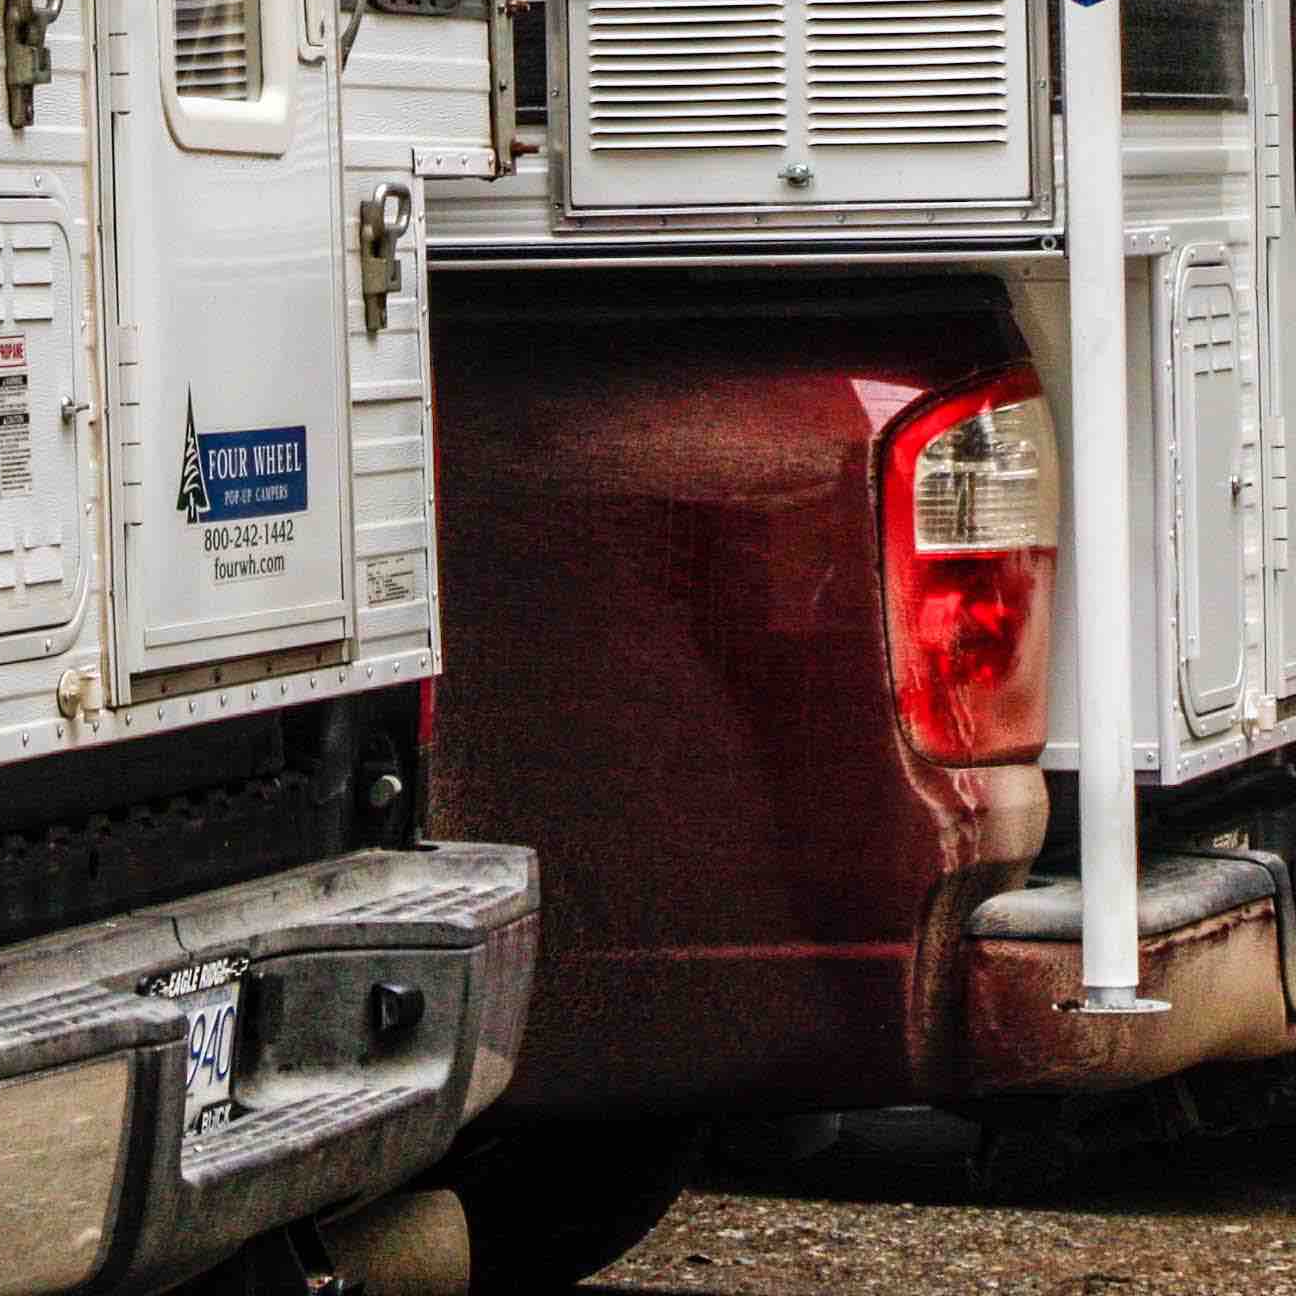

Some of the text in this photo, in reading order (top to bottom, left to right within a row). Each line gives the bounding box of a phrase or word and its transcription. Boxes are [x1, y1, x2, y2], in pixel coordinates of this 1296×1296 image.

[208, 442, 302, 480] FOUR WHEEL
[224, 484, 289, 505] POP-UP CAMPERS
[205, 519, 294, 552] 800-242-1442
[214, 553, 285, 580] fourwh.com
[168, 965, 201, 998] EAGLE
[184, 1006, 236, 1089] 940
